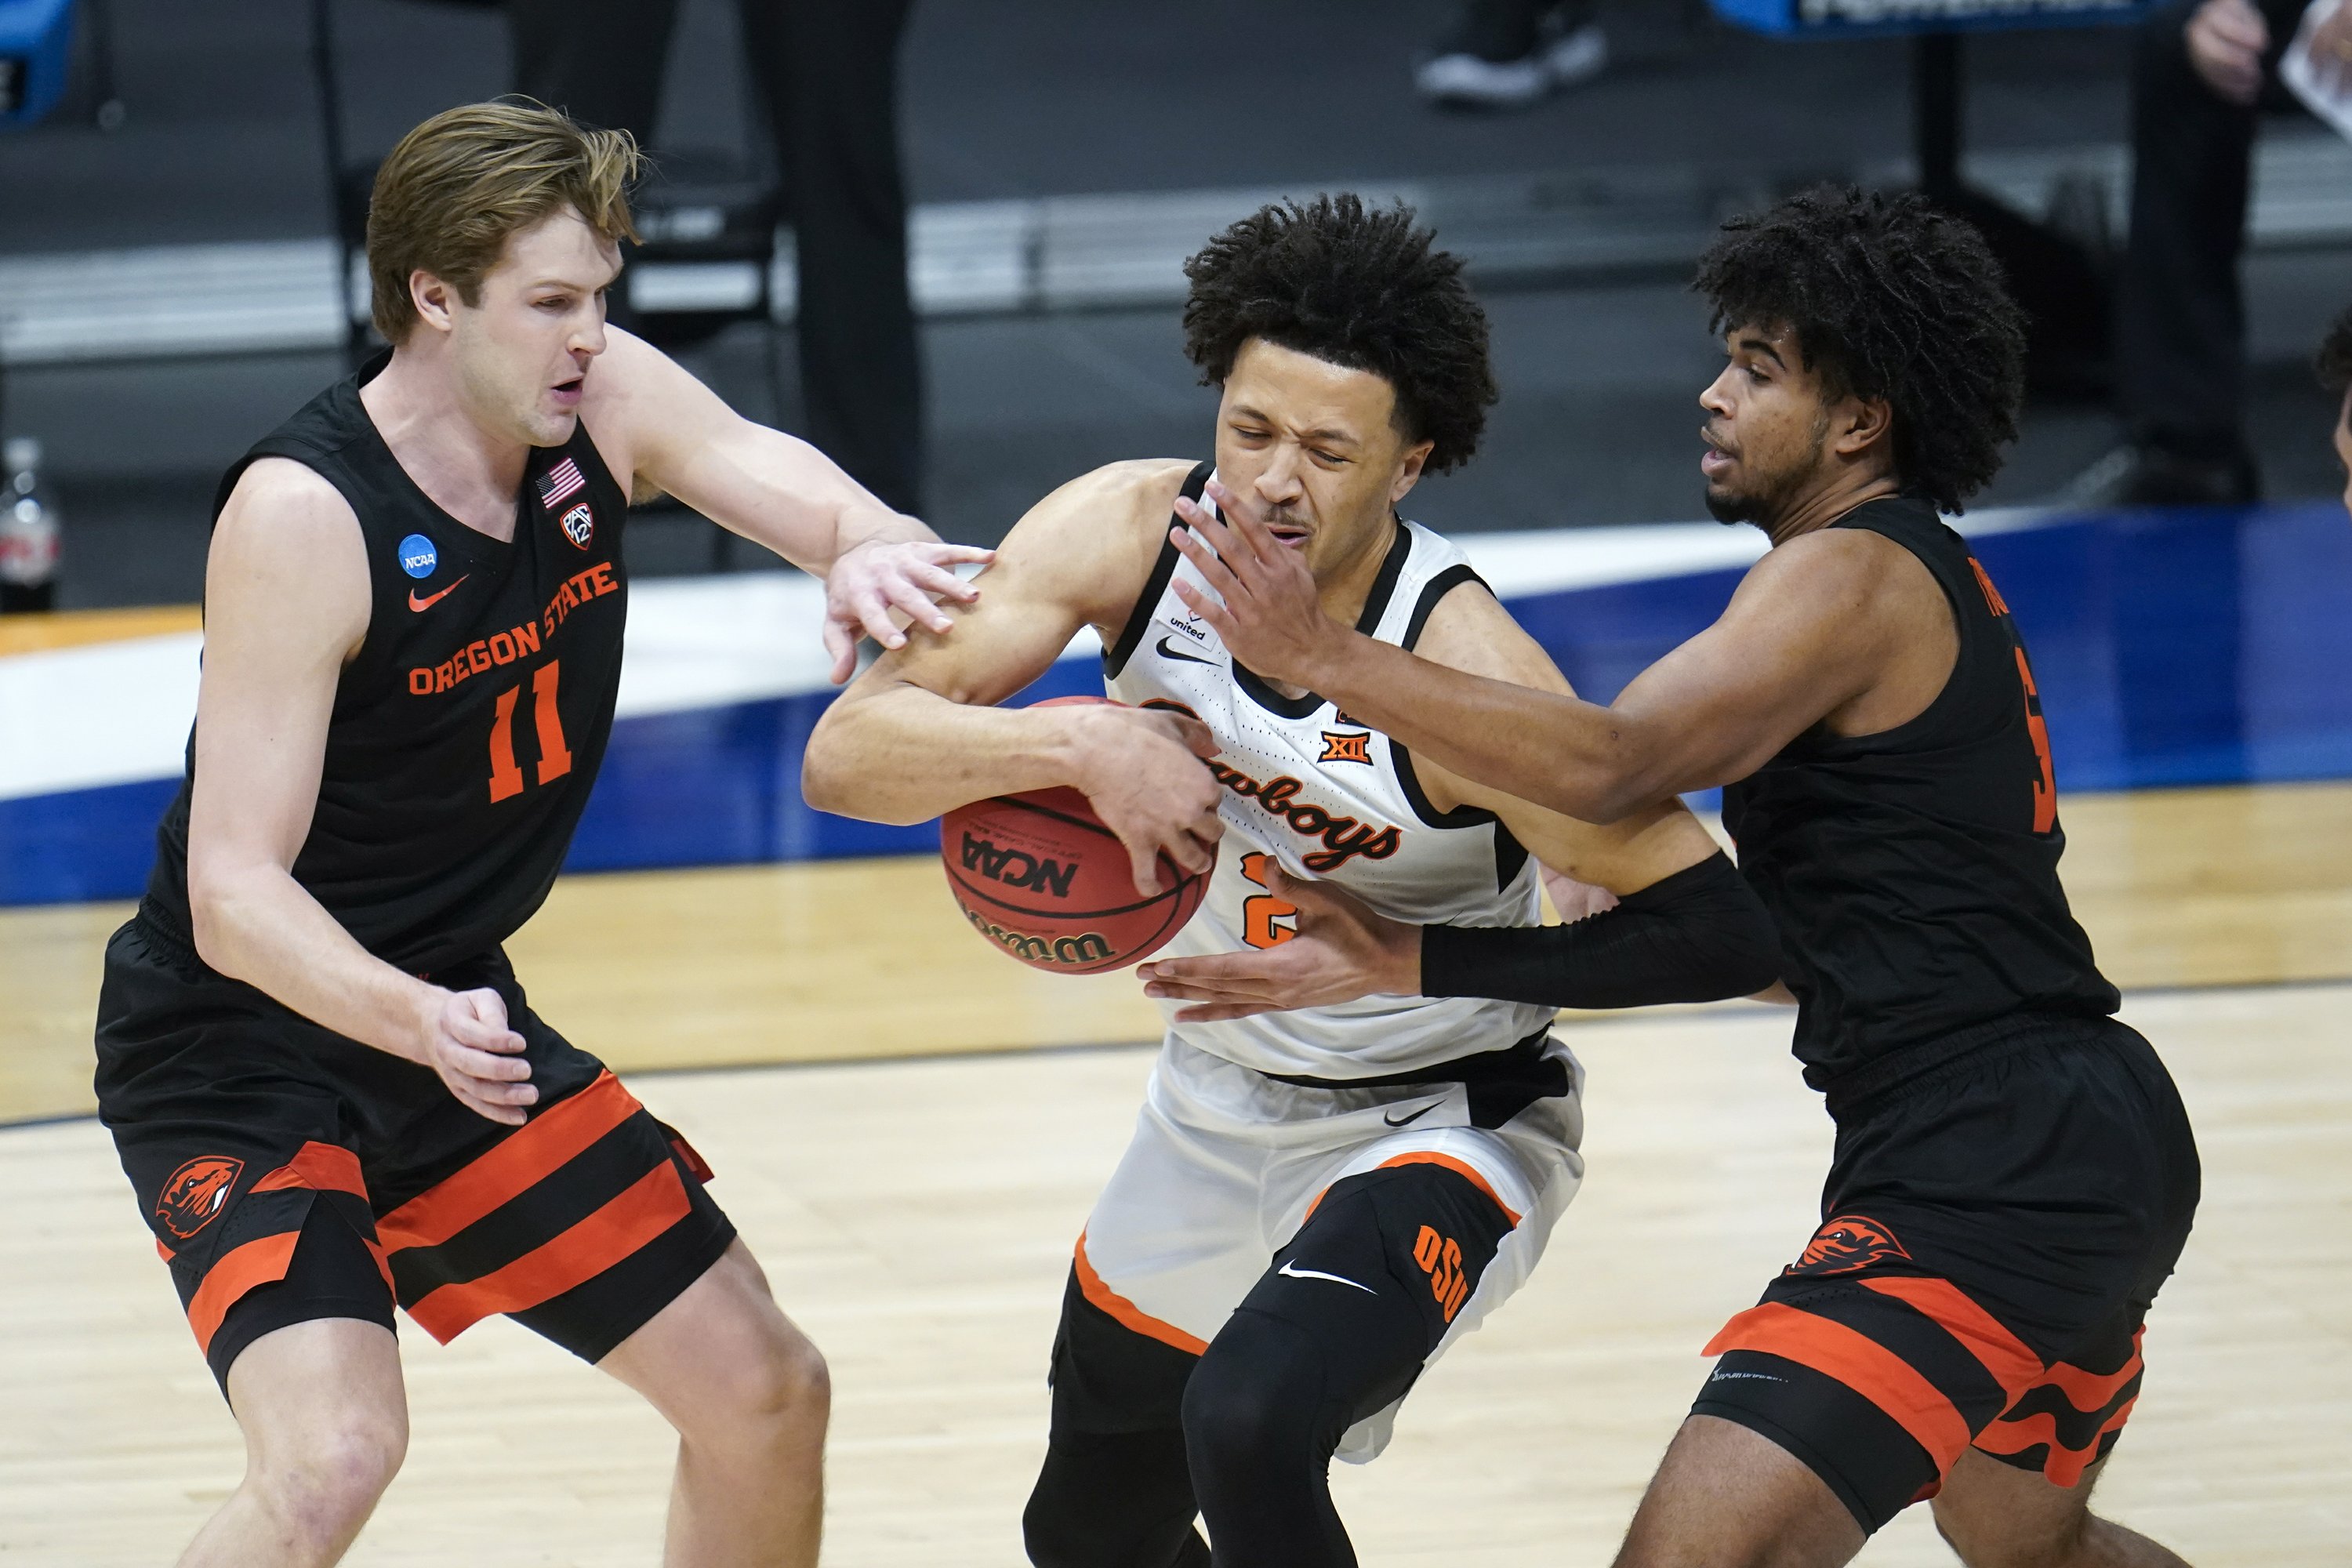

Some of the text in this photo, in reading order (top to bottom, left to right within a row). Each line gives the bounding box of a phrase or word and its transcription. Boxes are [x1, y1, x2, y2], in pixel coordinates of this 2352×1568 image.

[563, 506, 592, 539] PAC
[574, 524, 590, 544] 12
[405, 553, 436, 569] NCAA
[408, 561, 619, 695] OREGON STATE
[1170, 616, 1206, 641] united
[488, 659, 572, 804] 11
[1322, 734, 1371, 763] XII
[961, 830, 1080, 898] NCAA
[1240, 851, 1299, 950] 2
[1412, 1225, 1469, 1323] OSU
